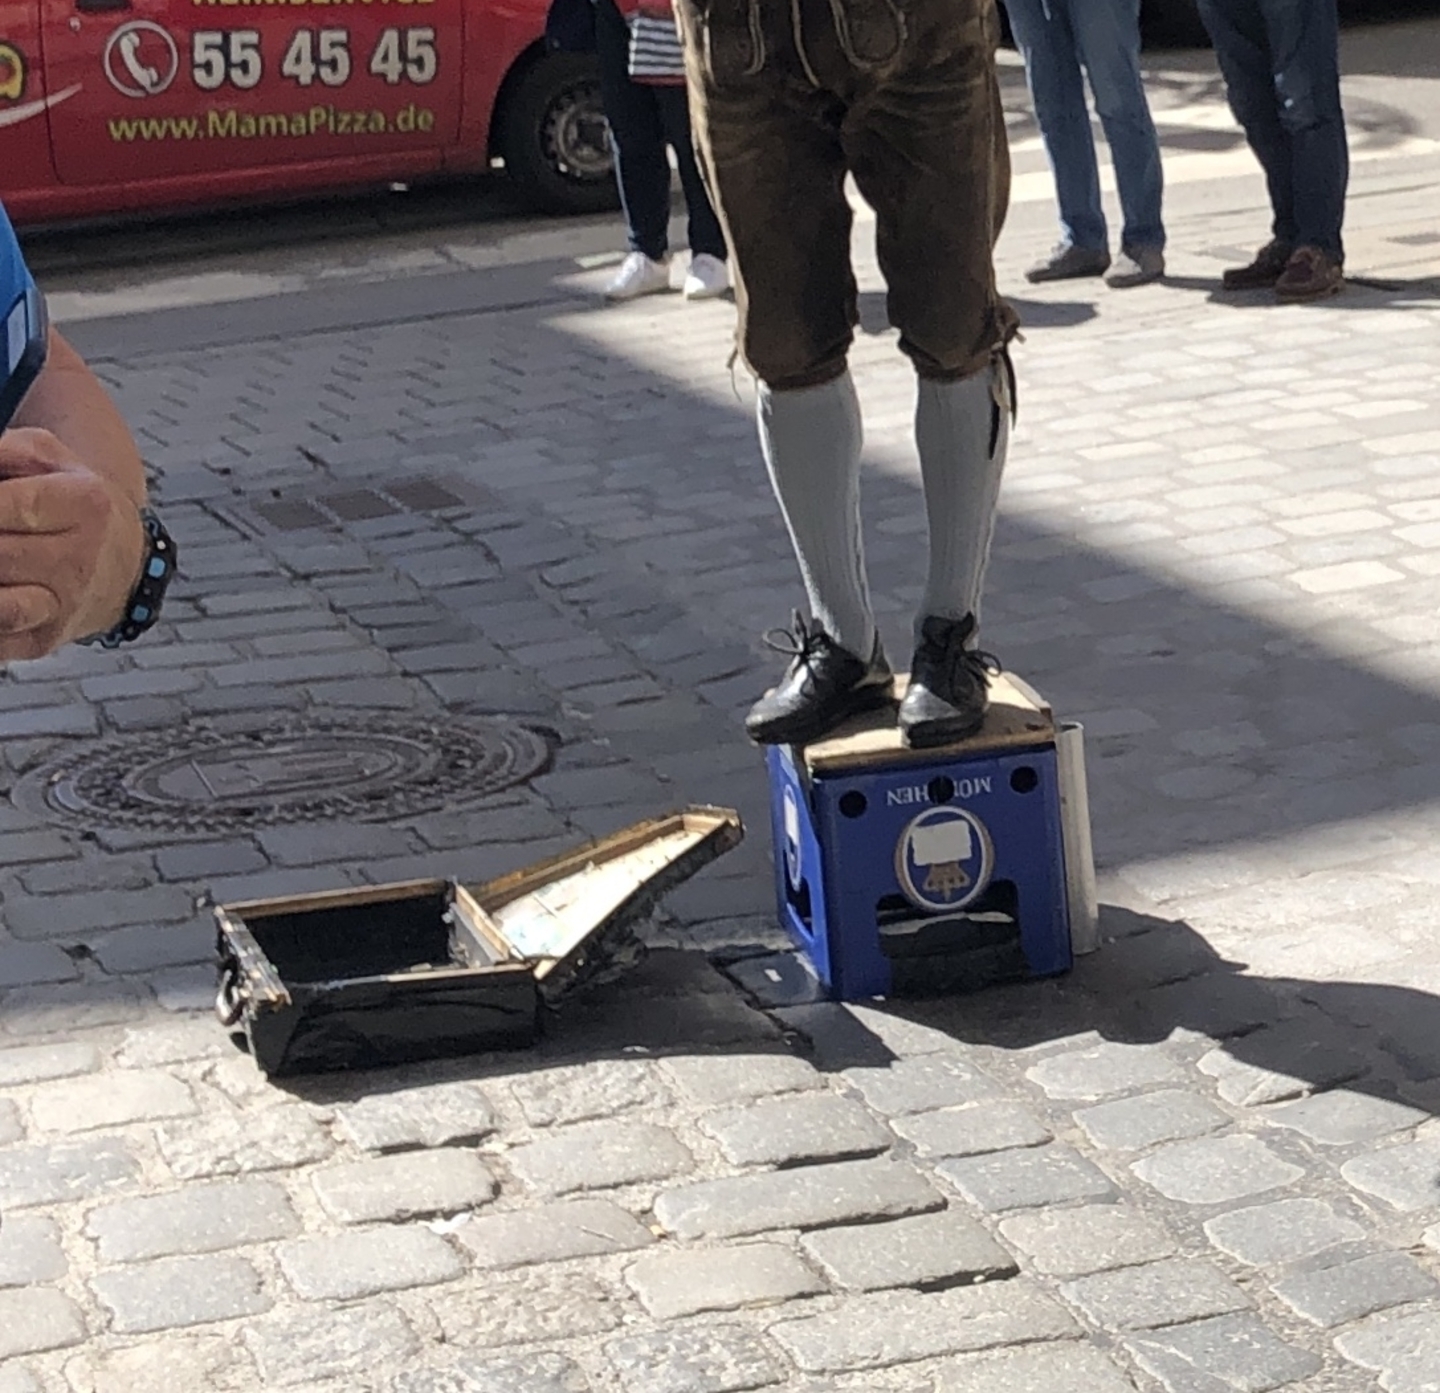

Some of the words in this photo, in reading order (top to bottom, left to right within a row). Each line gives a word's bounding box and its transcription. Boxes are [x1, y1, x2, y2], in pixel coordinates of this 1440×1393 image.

[191, 28, 263, 90] 55
[280, 28, 352, 88] 45
[369, 26, 438, 85] 45
[108, 104, 435, 142] www.MamaPizza.de
[886, 776, 992, 807] MÜHEN
